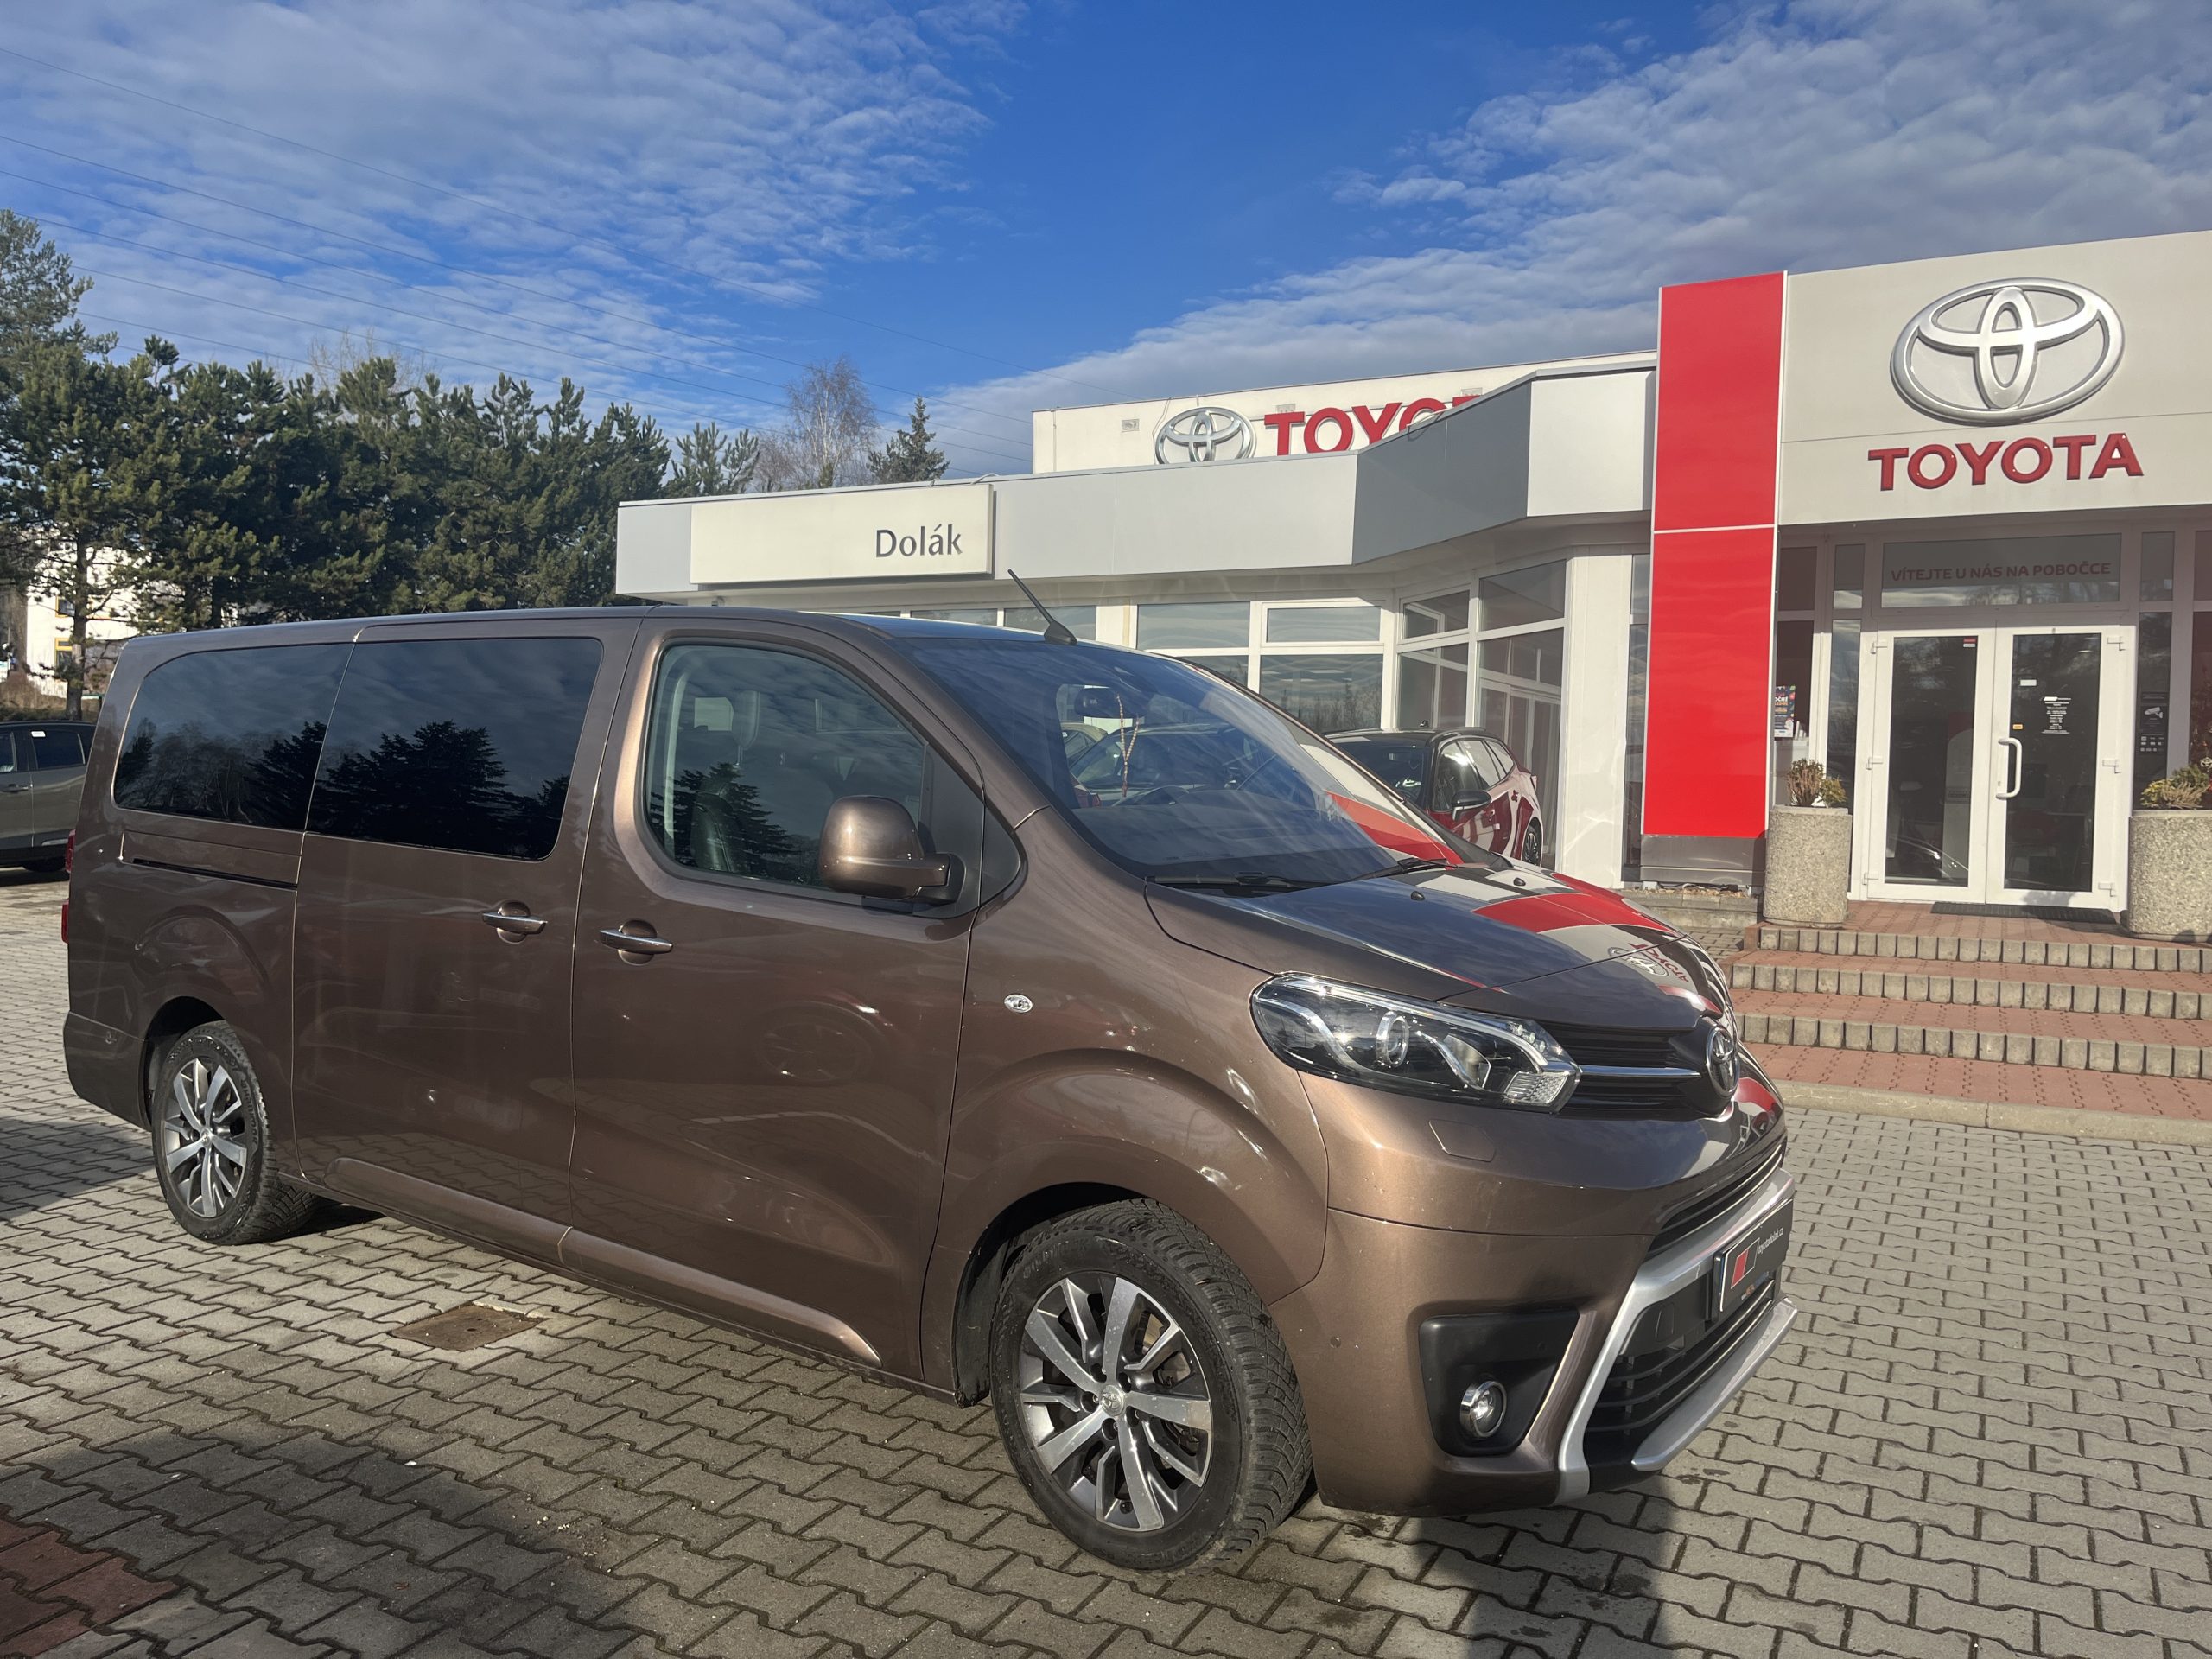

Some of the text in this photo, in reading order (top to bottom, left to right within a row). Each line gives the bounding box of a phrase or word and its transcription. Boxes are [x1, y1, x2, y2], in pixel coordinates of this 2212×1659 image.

[1868, 432, 2144, 492] TOYOTA
[875, 524, 963, 558] Dolák
[1891, 561, 2111, 581] VÍTEJTE U NÁS NA POBOČCE
